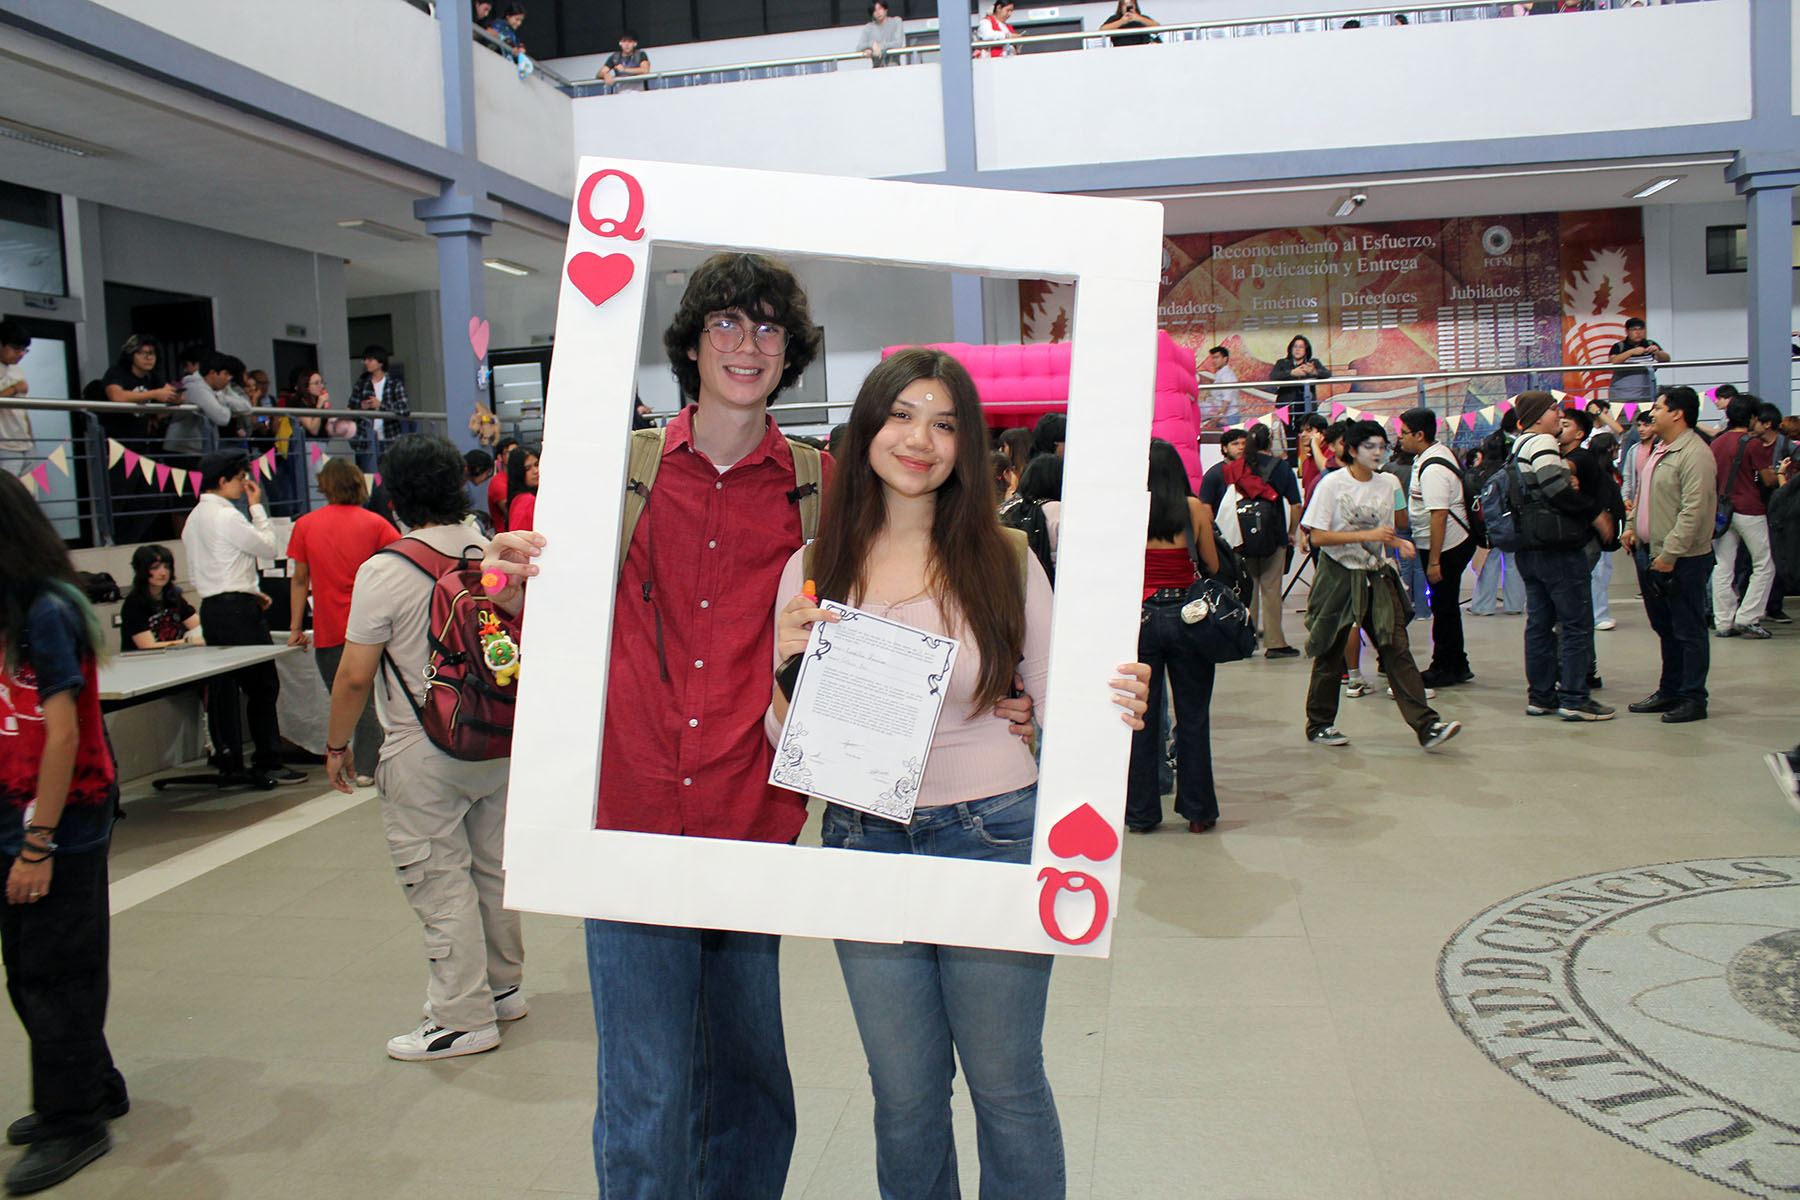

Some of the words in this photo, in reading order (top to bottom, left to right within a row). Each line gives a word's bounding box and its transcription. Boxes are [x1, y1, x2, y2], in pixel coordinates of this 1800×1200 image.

[577, 168, 645, 241] Q
[1211, 237, 1338, 260] Reconocimiento
[1343, 237, 1357, 251] al
[1362, 235, 1437, 250] Esfuerzo,
[1232, 265, 1245, 280] la
[1251, 260, 1338, 278] Dedicación
[1343, 262, 1353, 277] y
[1357, 257, 1418, 274] Entrega
[1484, 257, 1512, 267] FCFM
[1341, 291, 1418, 306] Directores
[1450, 284, 1521, 300] Jubilados
[1158, 301, 1224, 316] ndadores
[1252, 296, 1317, 311] Eméritos
[1037, 867, 1109, 946] Q
[1475, 861, 1793, 953] CIENCIAS
